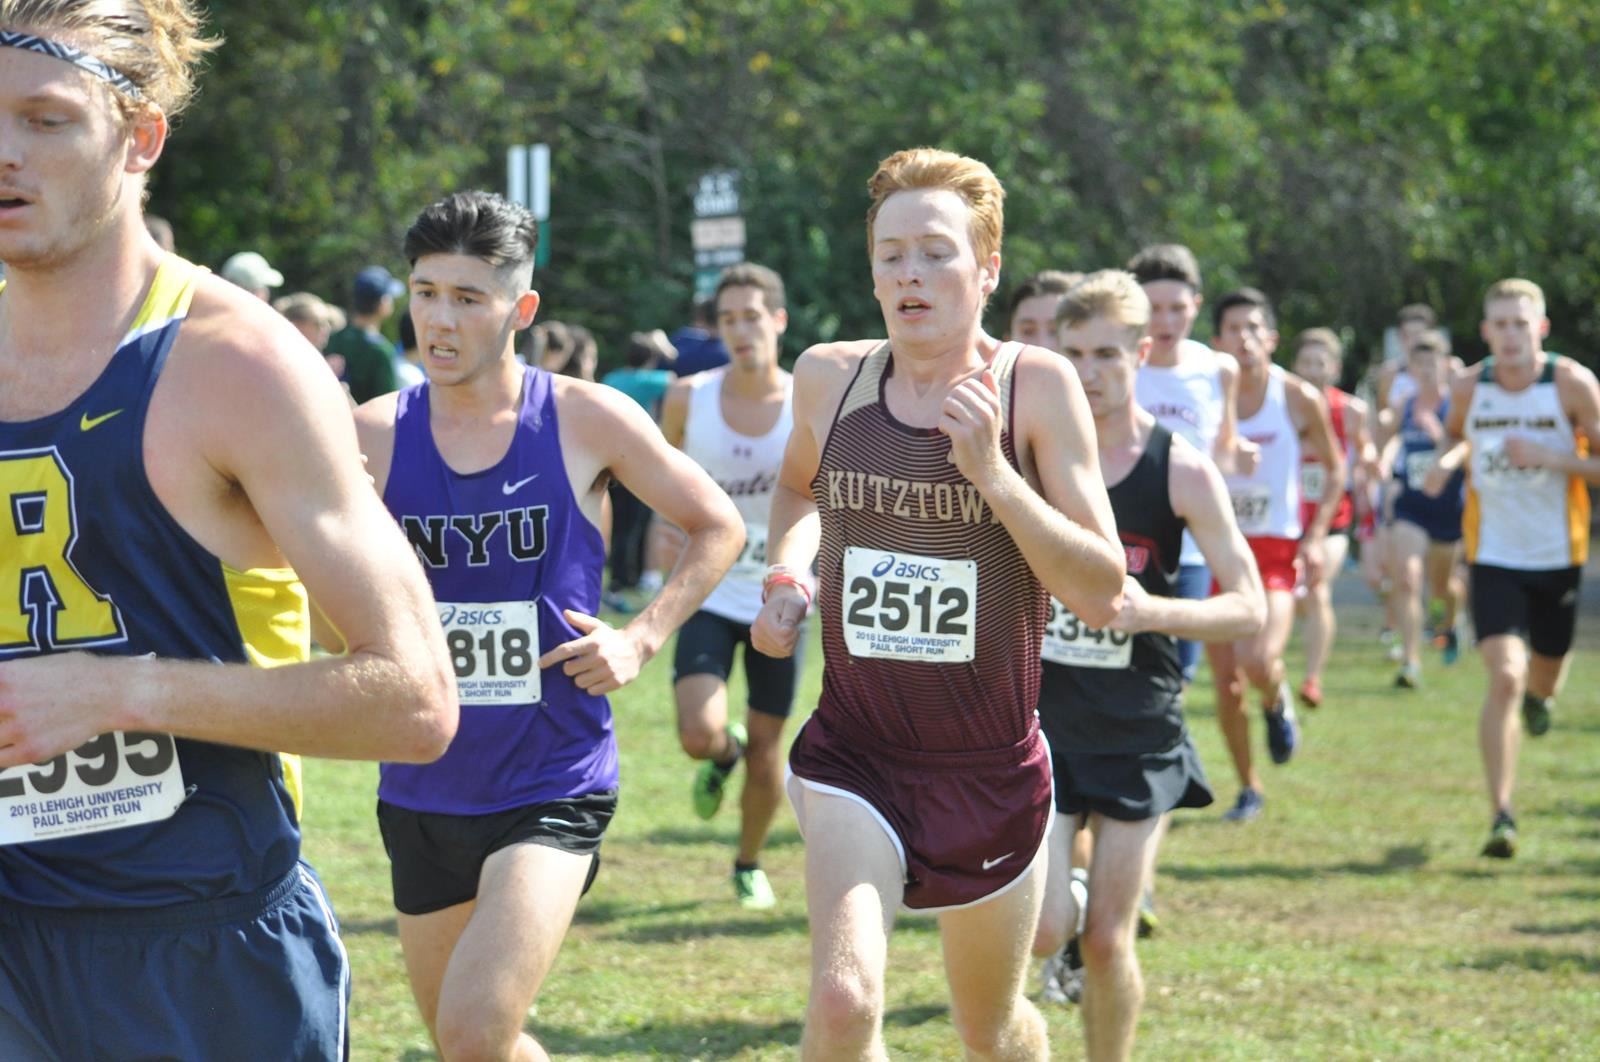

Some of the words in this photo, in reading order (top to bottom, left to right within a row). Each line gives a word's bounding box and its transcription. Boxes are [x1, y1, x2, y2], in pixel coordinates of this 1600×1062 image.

[828, 471, 1002, 525] KUTZTOW
[0, 445, 128, 652] R
[401, 504, 549, 568] NYU
[895, 562, 941, 582] asics
[457, 610, 502, 625] asics
[847, 576, 969, 635] 2512
[446, 628, 533, 677] 818
[856, 631, 876, 642] 2018
[877, 633, 909, 646] LEHIGH
[911, 636, 962, 648] UNIVERSITY
[870, 642, 891, 652] PAUL
[895, 644, 923, 654] SHORT
[926, 646, 945, 655] RUN
[464, 689, 492, 697] SHORT
[495, 689, 512, 697] RUN
[480, 680, 527, 688] UNIVERSITY
[0, 731, 174, 797] 995
[10, 803, 38, 818] 2018
[40, 797, 85, 814] LEHIGH
[86, 782, 163, 807] UNIVERSITY
[33, 814, 64, 829] PAUL
[67, 806, 108, 823] SHORT
[113, 800, 142, 816] RUN
